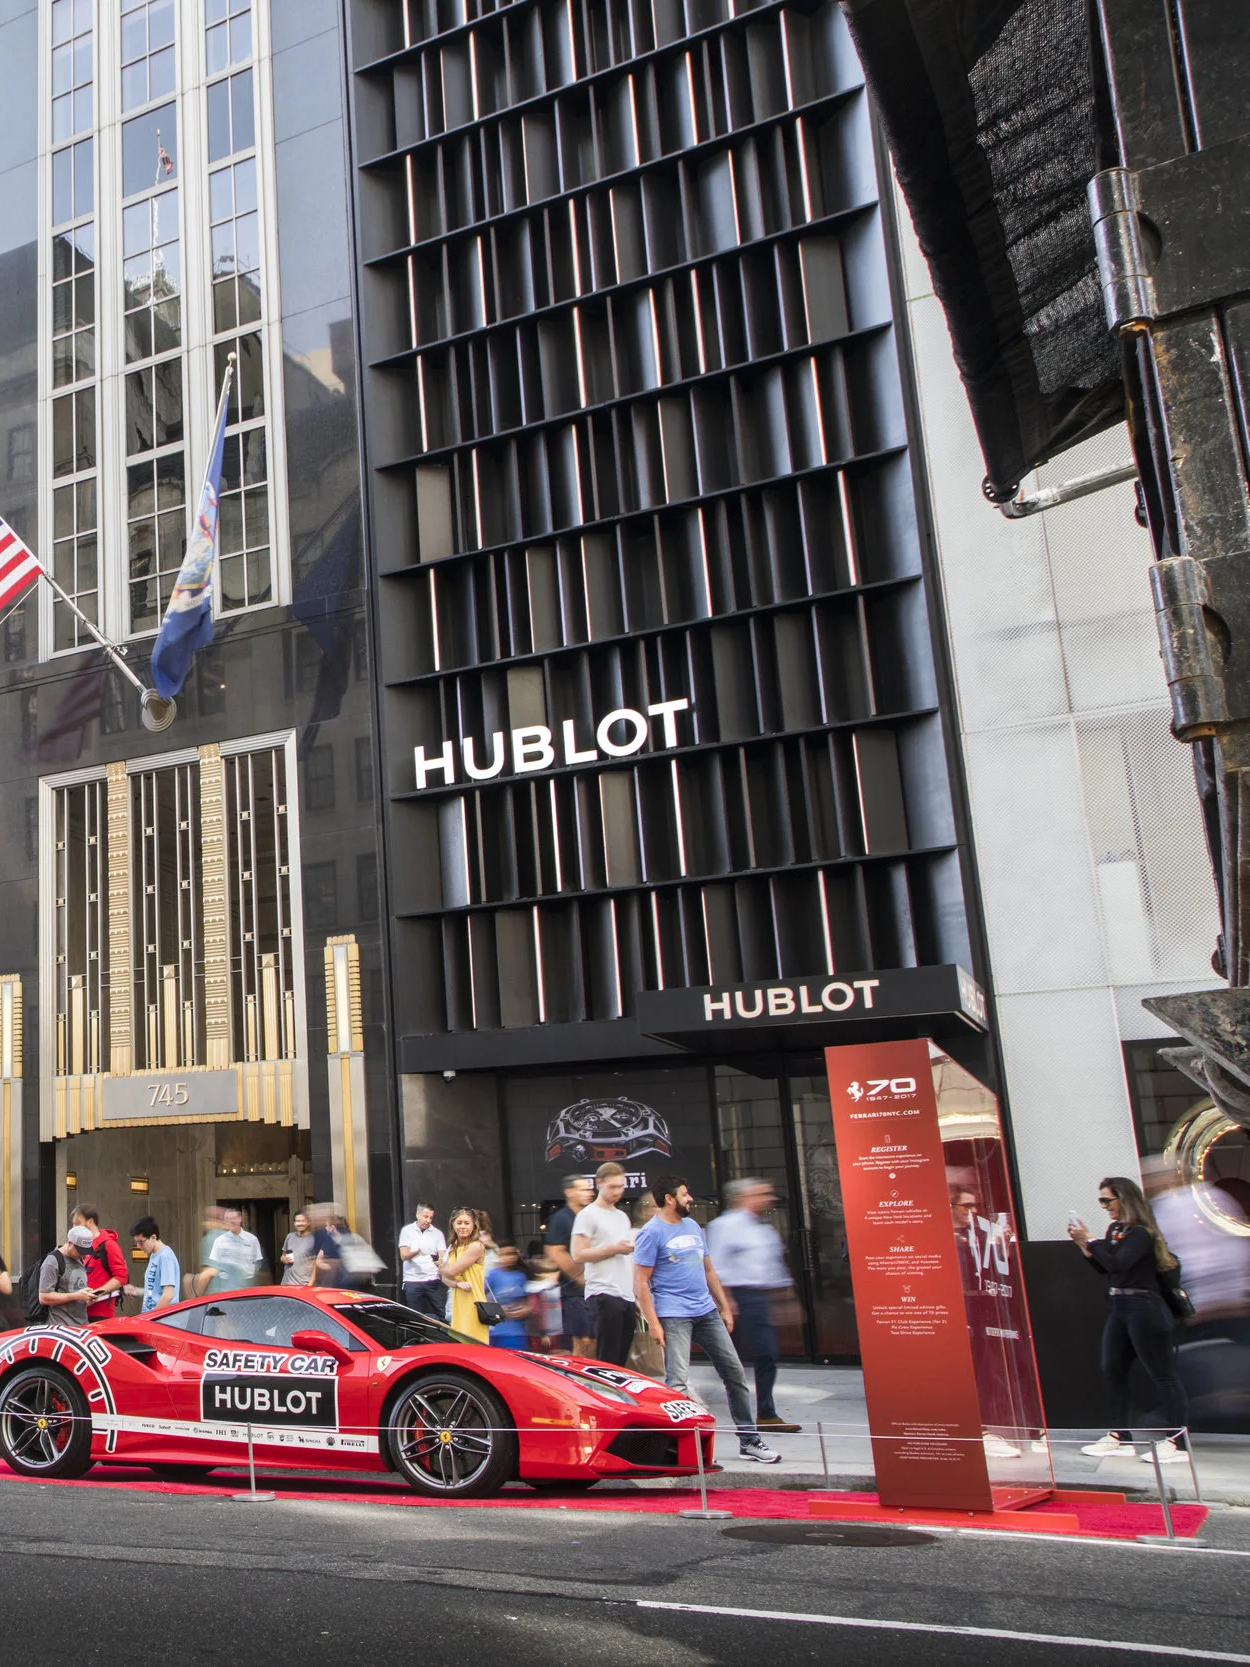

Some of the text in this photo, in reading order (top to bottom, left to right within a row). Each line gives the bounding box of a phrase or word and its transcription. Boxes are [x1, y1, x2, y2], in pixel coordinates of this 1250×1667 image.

[414, 698, 689, 790] HUBLOT
[704, 979, 880, 1021] HUBLOT
[148, 1082, 190, 1108] 745
[866, 1077, 917, 1096] 70
[850, 1109, 921, 1119] FERRARI70NYC.COM
[871, 1145, 908, 1153] REGISTER
[879, 1200, 913, 1208] EXPLORE
[204, 1350, 337, 1374] SAFETY CAR
[214, 1385, 322, 1415] HUBLOT
